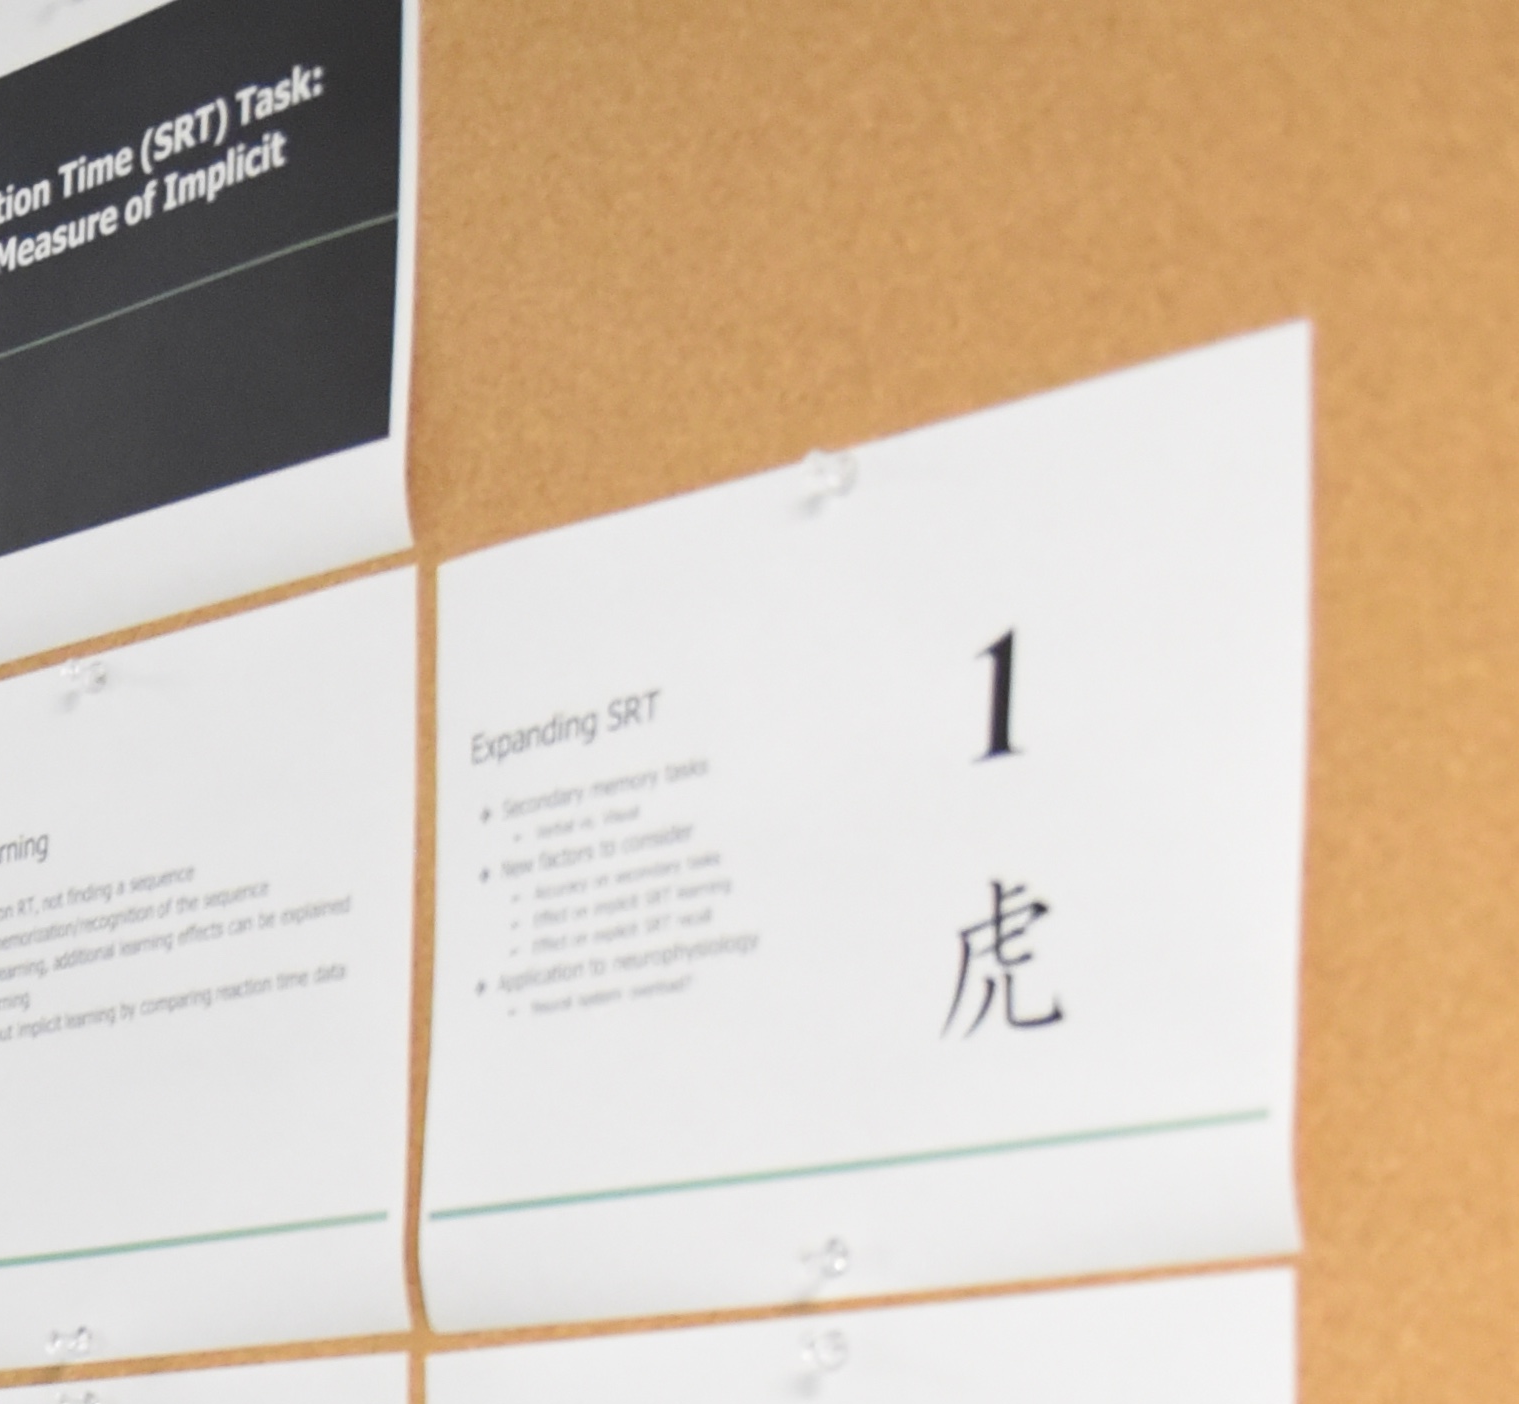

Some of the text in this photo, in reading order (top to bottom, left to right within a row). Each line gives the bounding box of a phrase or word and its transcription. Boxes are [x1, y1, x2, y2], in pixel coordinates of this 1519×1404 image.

[59, 148, 134, 197] Time
[140, 99, 229, 172] (SRT)
[237, 67, 323, 124] Task:
[124, 180, 157, 225] of
[164, 133, 286, 209] Implicit
[471, 689, 660, 764] Expanding SRT
[973, 627, 1026, 764] 1
[42, 892, 64, 911] not
[66, 883, 114, 905] finding
[116, 880, 126, 896] a
[129, 866, 196, 893] sequence
[940, 879, 1066, 1040] 虎
